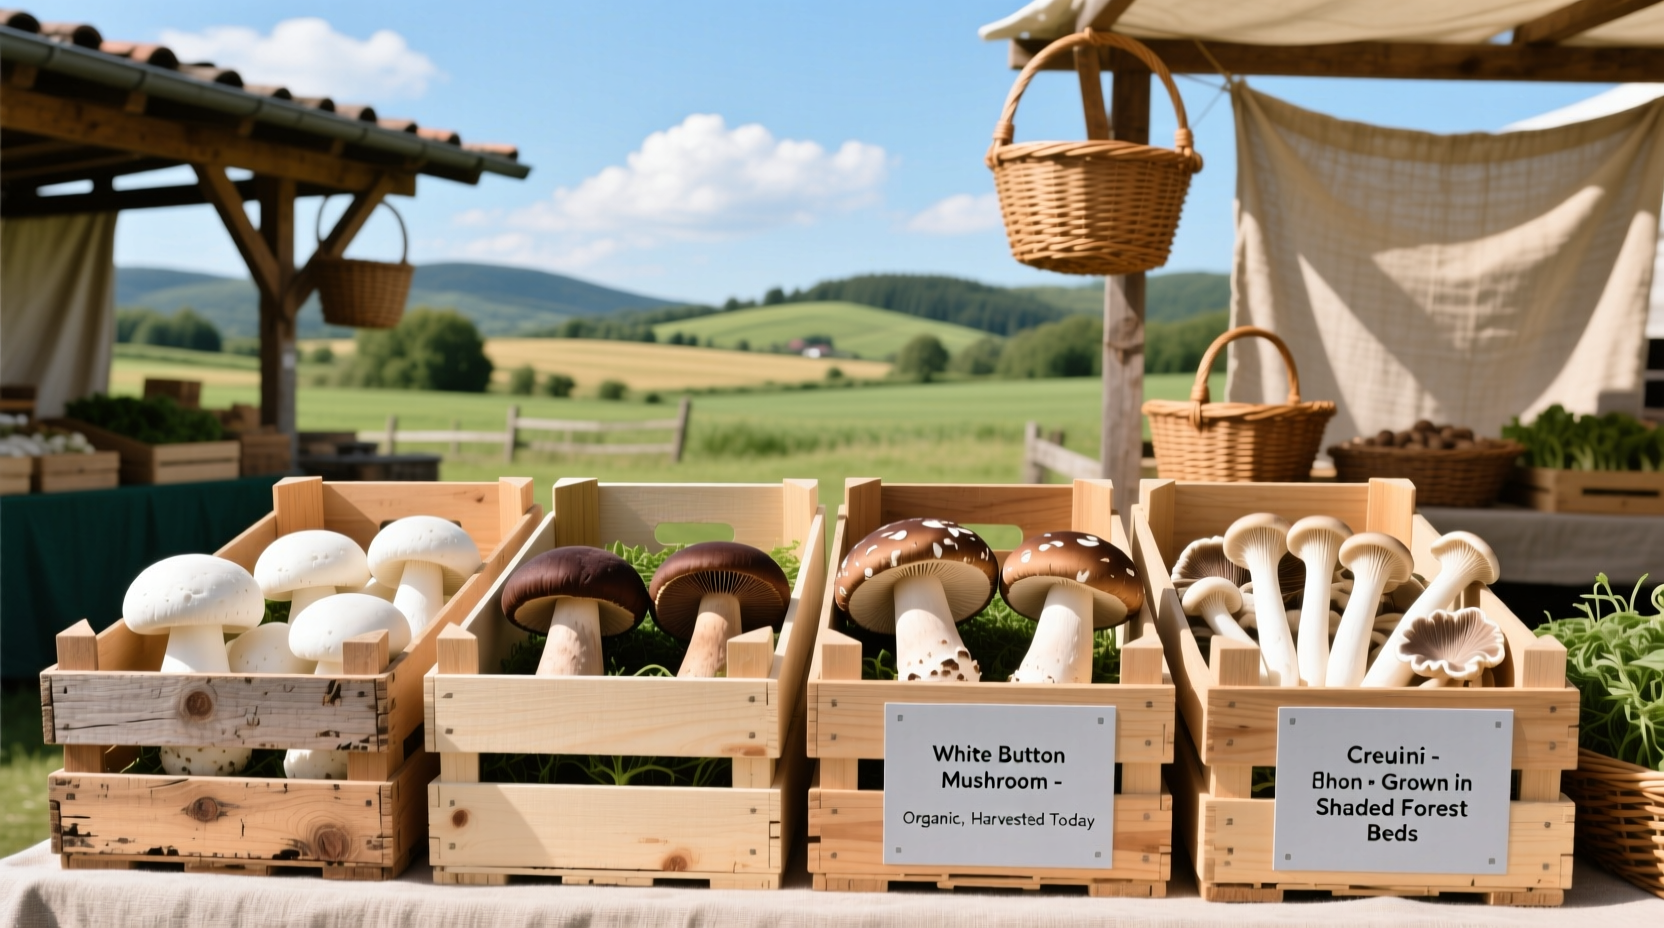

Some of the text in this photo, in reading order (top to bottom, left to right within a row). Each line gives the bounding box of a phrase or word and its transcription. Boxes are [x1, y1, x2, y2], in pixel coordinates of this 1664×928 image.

[932, 744, 1066, 764] White Button
[1346, 745, 1426, 765] Creuini
[941, 771, 1048, 790] Mushroom
[1381, 773, 1449, 791] Grown
[1454, 773, 1472, 792] in
[1315, 797, 1469, 818] Shaded Forest
[902, 810, 1095, 831] Organic, Harvested Today
[1367, 823, 1418, 842] Beds
